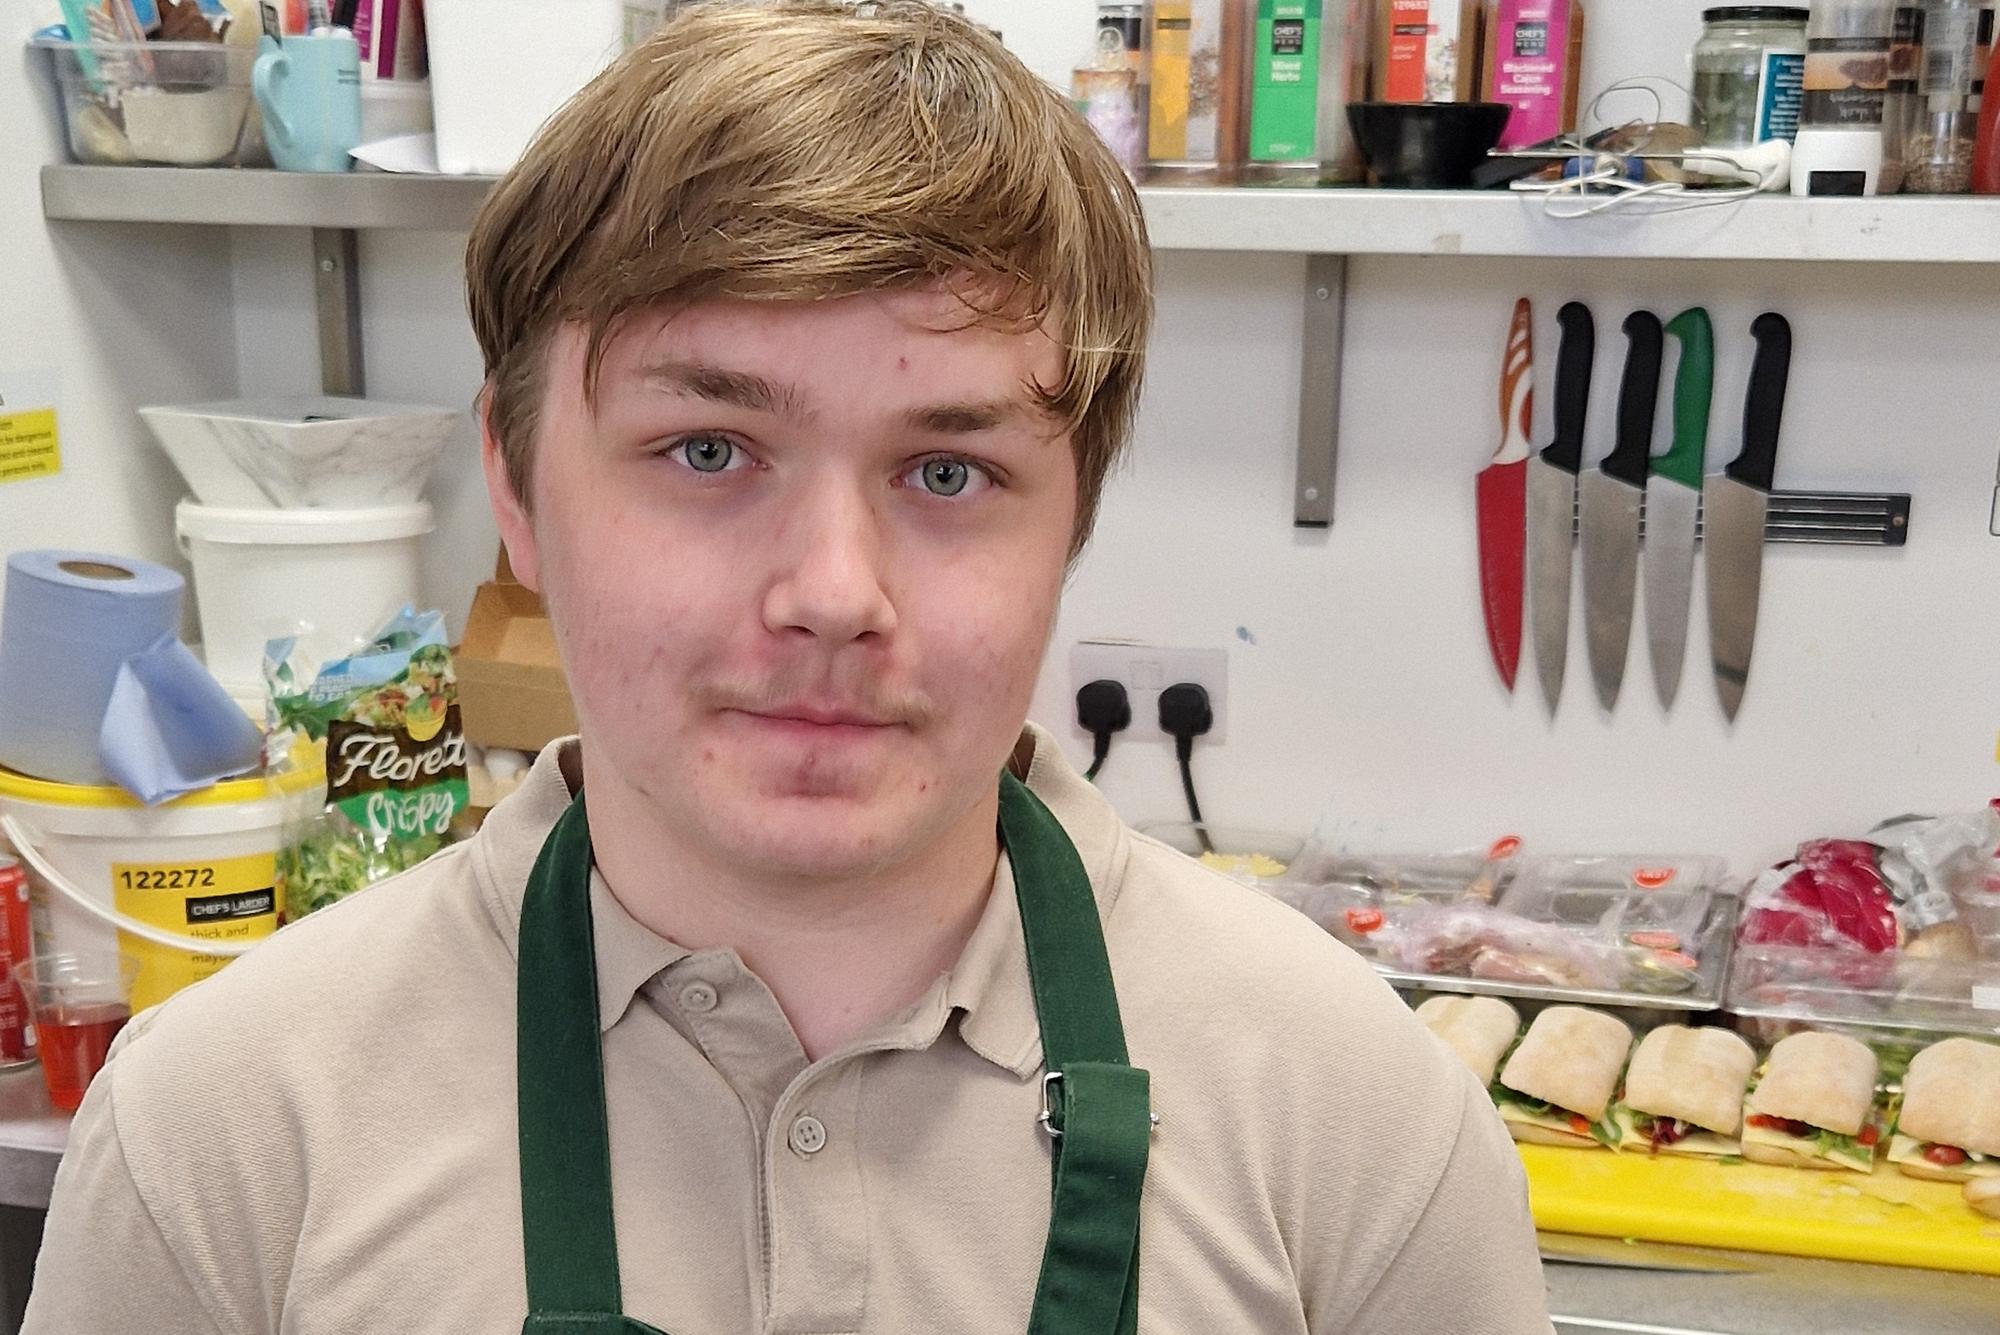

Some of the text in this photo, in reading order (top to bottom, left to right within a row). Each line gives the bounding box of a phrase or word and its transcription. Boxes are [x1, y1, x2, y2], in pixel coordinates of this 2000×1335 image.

[1515, 29, 1547, 38] CHEF'S
[1500, 84, 1552, 96] Seasoning
[366, 791, 455, 837] Crispy
[121, 867, 216, 890] 122272
[192, 895, 271, 917] CHEF'S LARDER
[226, 924, 250, 937] and
